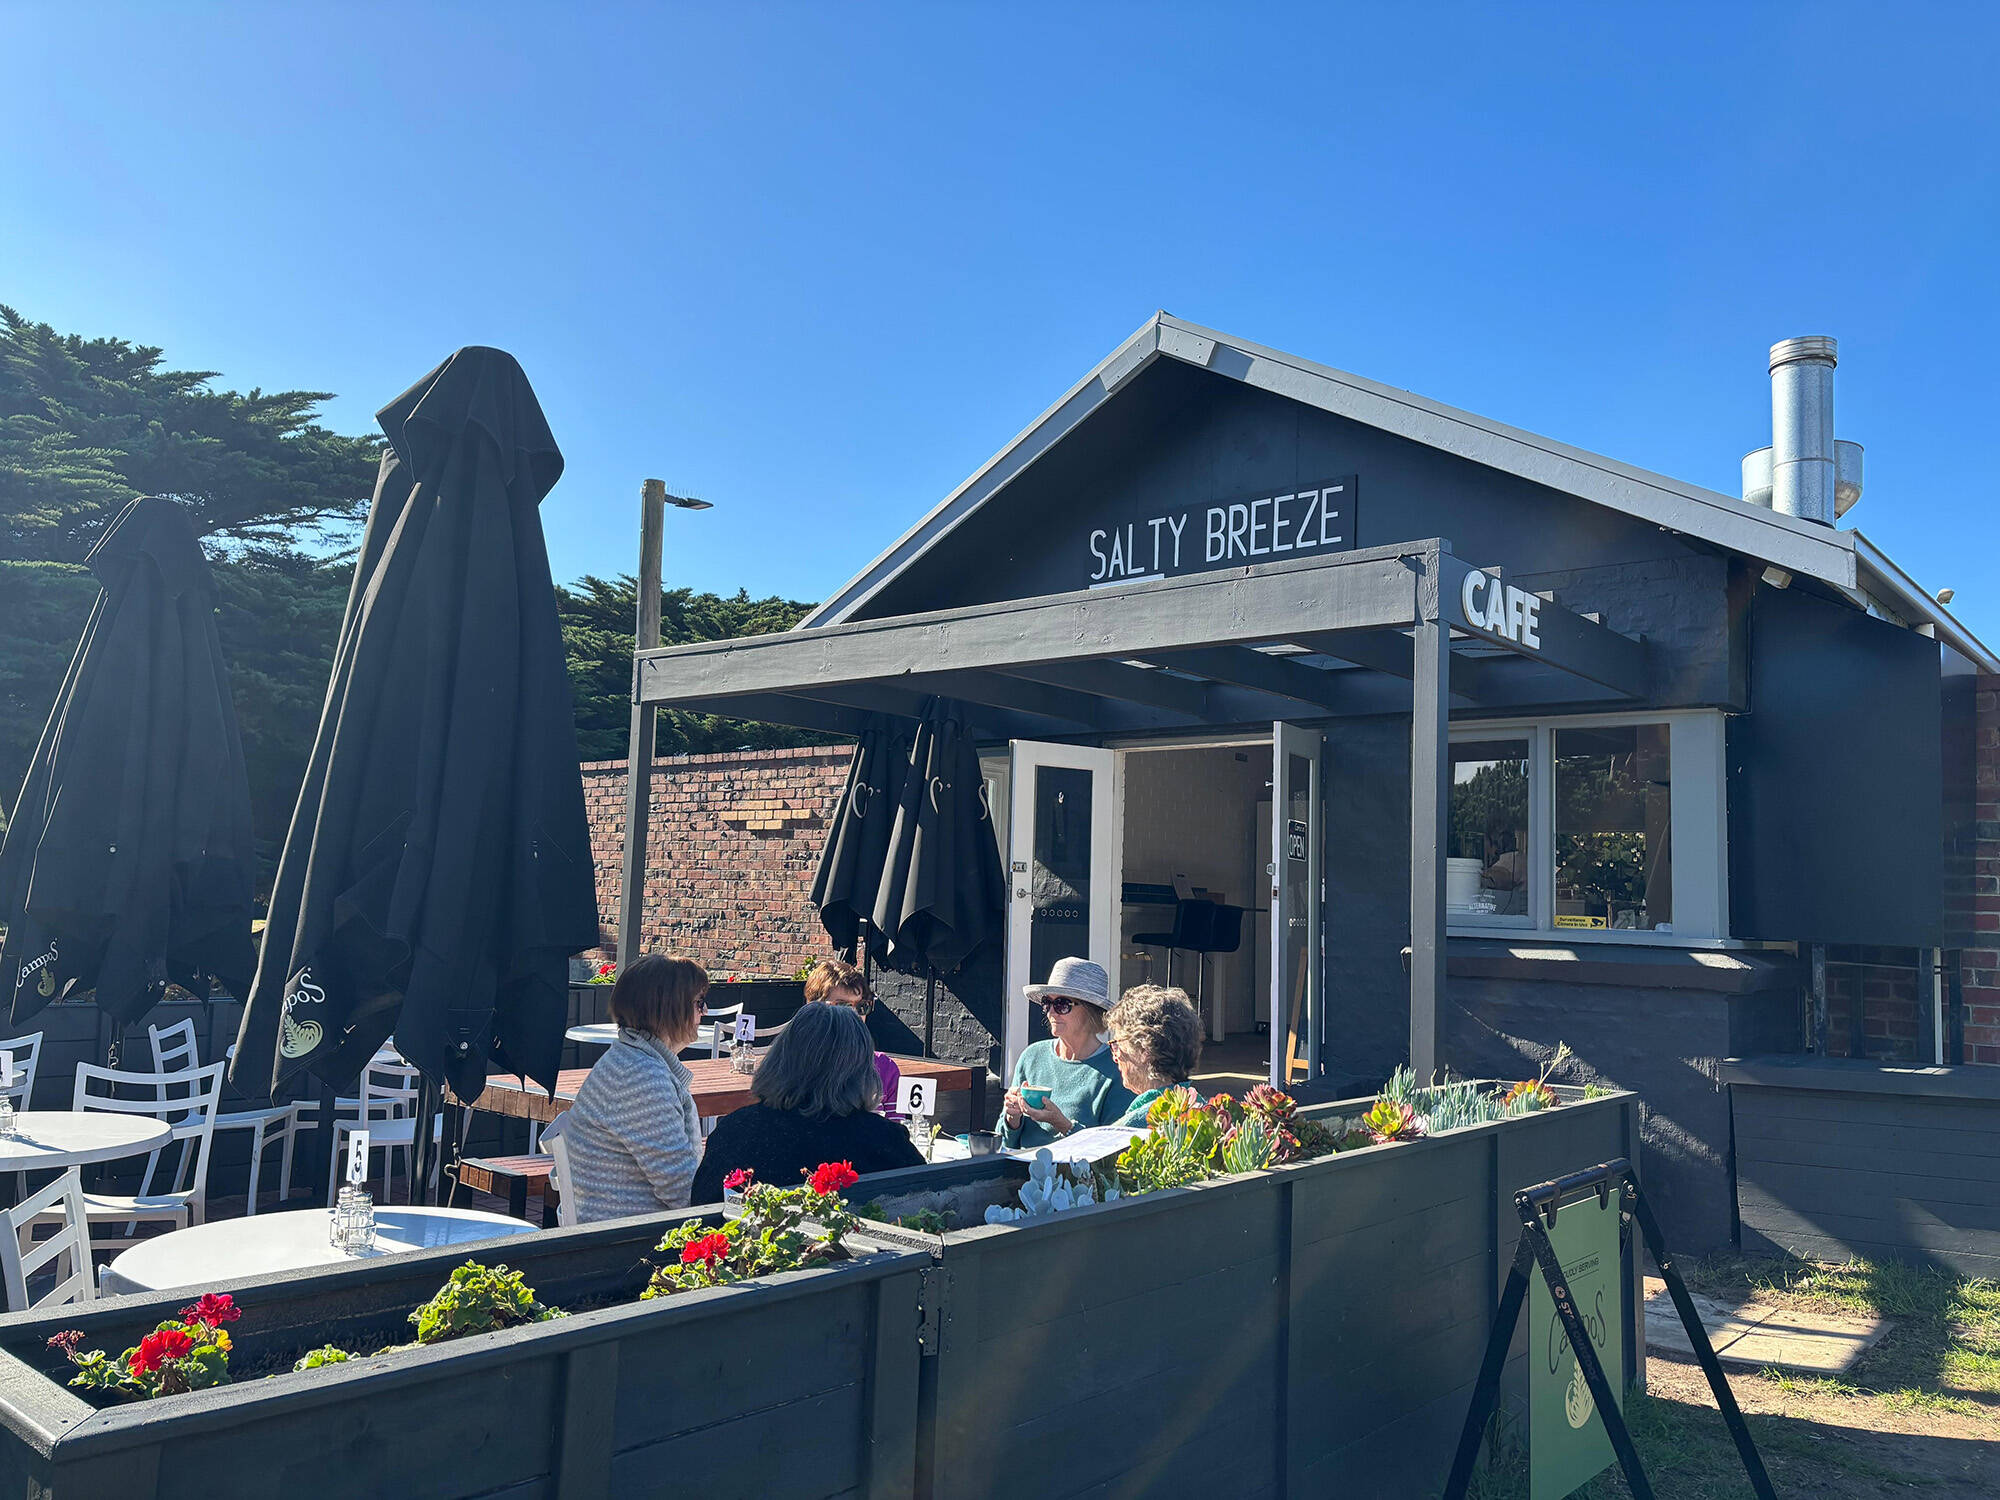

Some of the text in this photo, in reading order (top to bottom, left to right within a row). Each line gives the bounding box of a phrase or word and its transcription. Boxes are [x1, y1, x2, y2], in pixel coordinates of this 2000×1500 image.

[1089, 485, 1344, 580] SALTY BREEZE
[1462, 570, 1540, 649] CAFE
[1289, 834, 1305, 858] OPEN
[741, 1018, 750, 1036] 7
[910, 1083, 923, 1109] 6
[355, 1139, 362, 1173] 5
